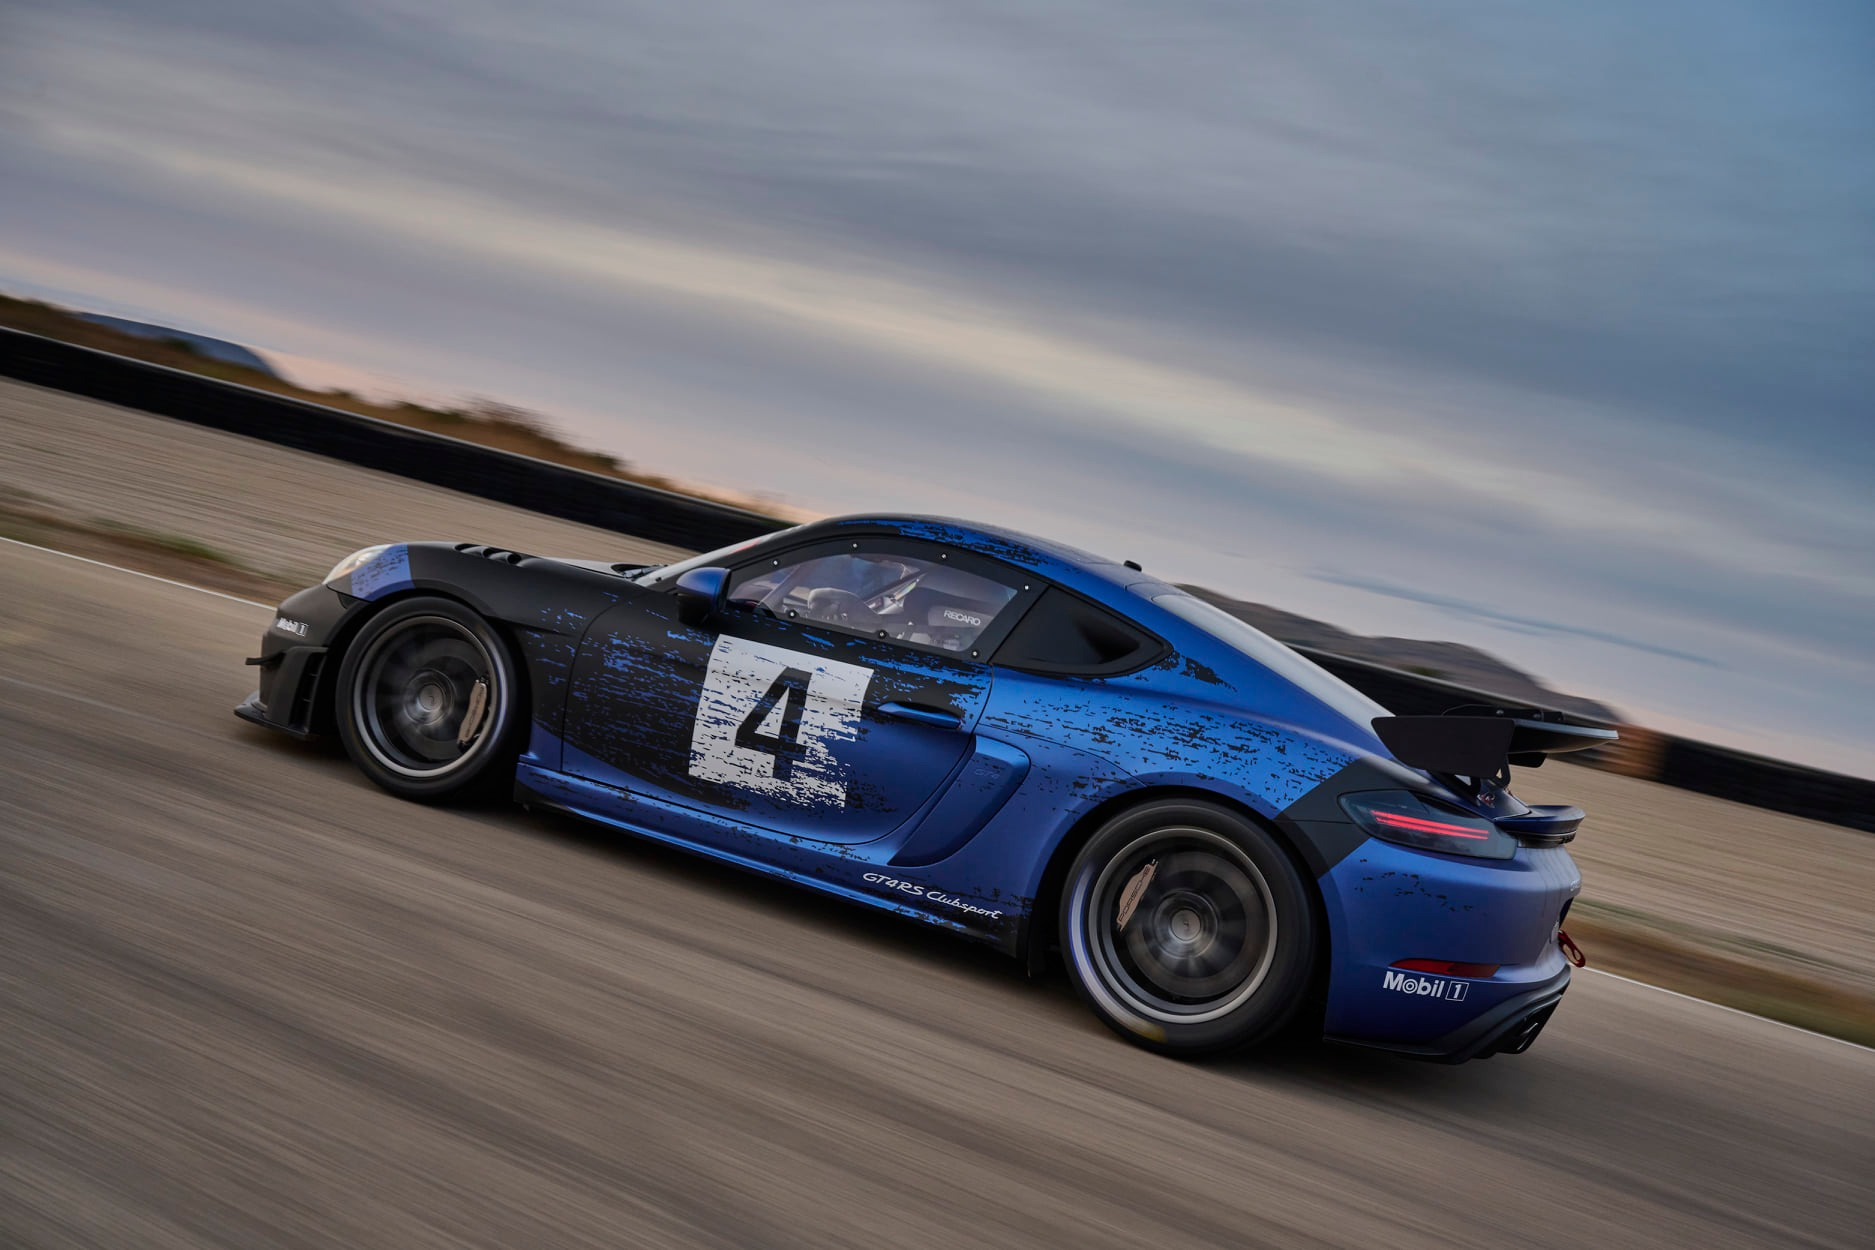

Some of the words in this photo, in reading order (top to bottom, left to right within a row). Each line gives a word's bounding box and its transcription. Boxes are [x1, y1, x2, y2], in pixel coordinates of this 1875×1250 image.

[943, 610, 981, 626] RECARO
[734, 666, 812, 780] 4
[926, 891, 1003, 919] Clubsport
[1119, 865, 1151, 922] PORSCHE
[1382, 970, 1445, 998] Mobil
